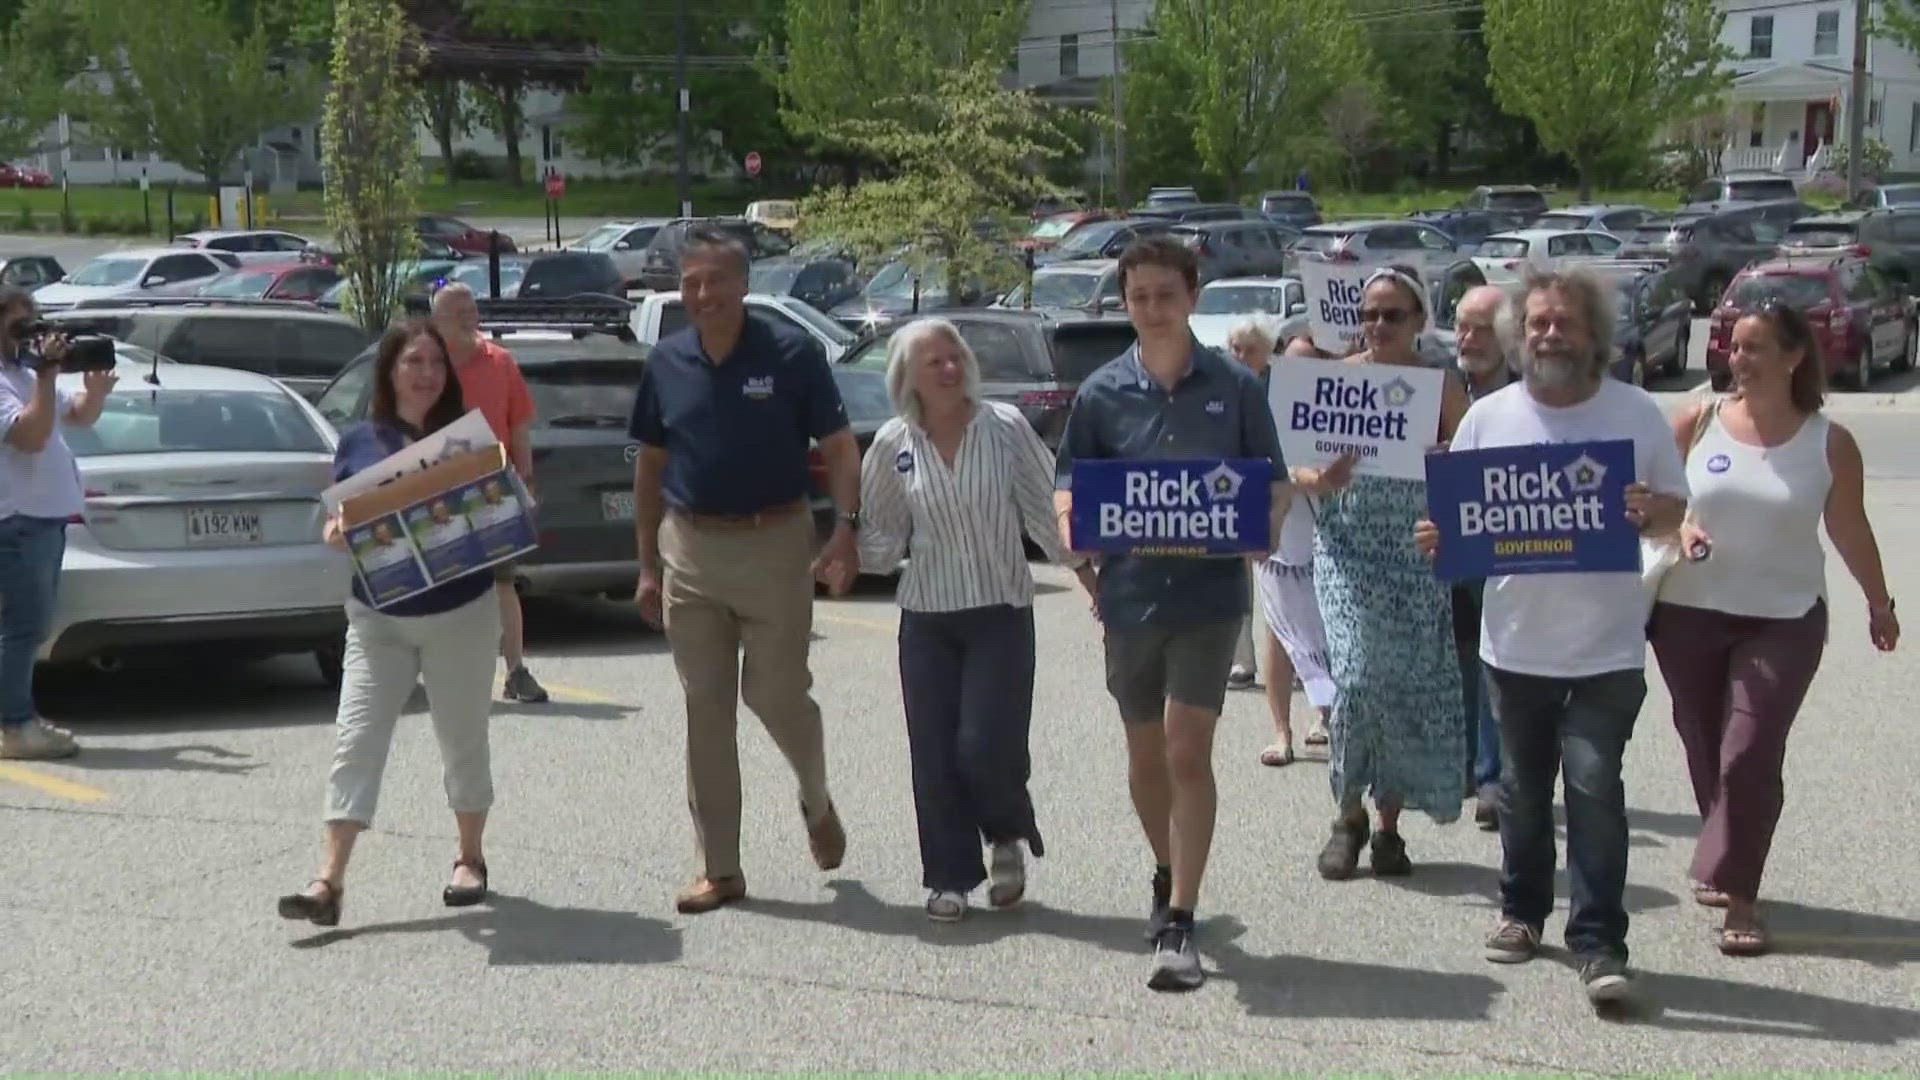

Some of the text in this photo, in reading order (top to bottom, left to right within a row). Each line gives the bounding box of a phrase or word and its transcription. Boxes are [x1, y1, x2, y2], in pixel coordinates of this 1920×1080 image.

[1320, 299, 1363, 326] Ben
[1315, 376, 1378, 411] Rick
[1291, 401, 1408, 441] Bennett
[1315, 440, 1378, 458] GOVERNOR
[1126, 469, 1201, 507] Rick
[1483, 462, 1564, 502] Rick
[1100, 503, 1239, 540] Bennett
[1459, 495, 1605, 536] Bennett
[1494, 539, 1573, 555] GOVERNOR
